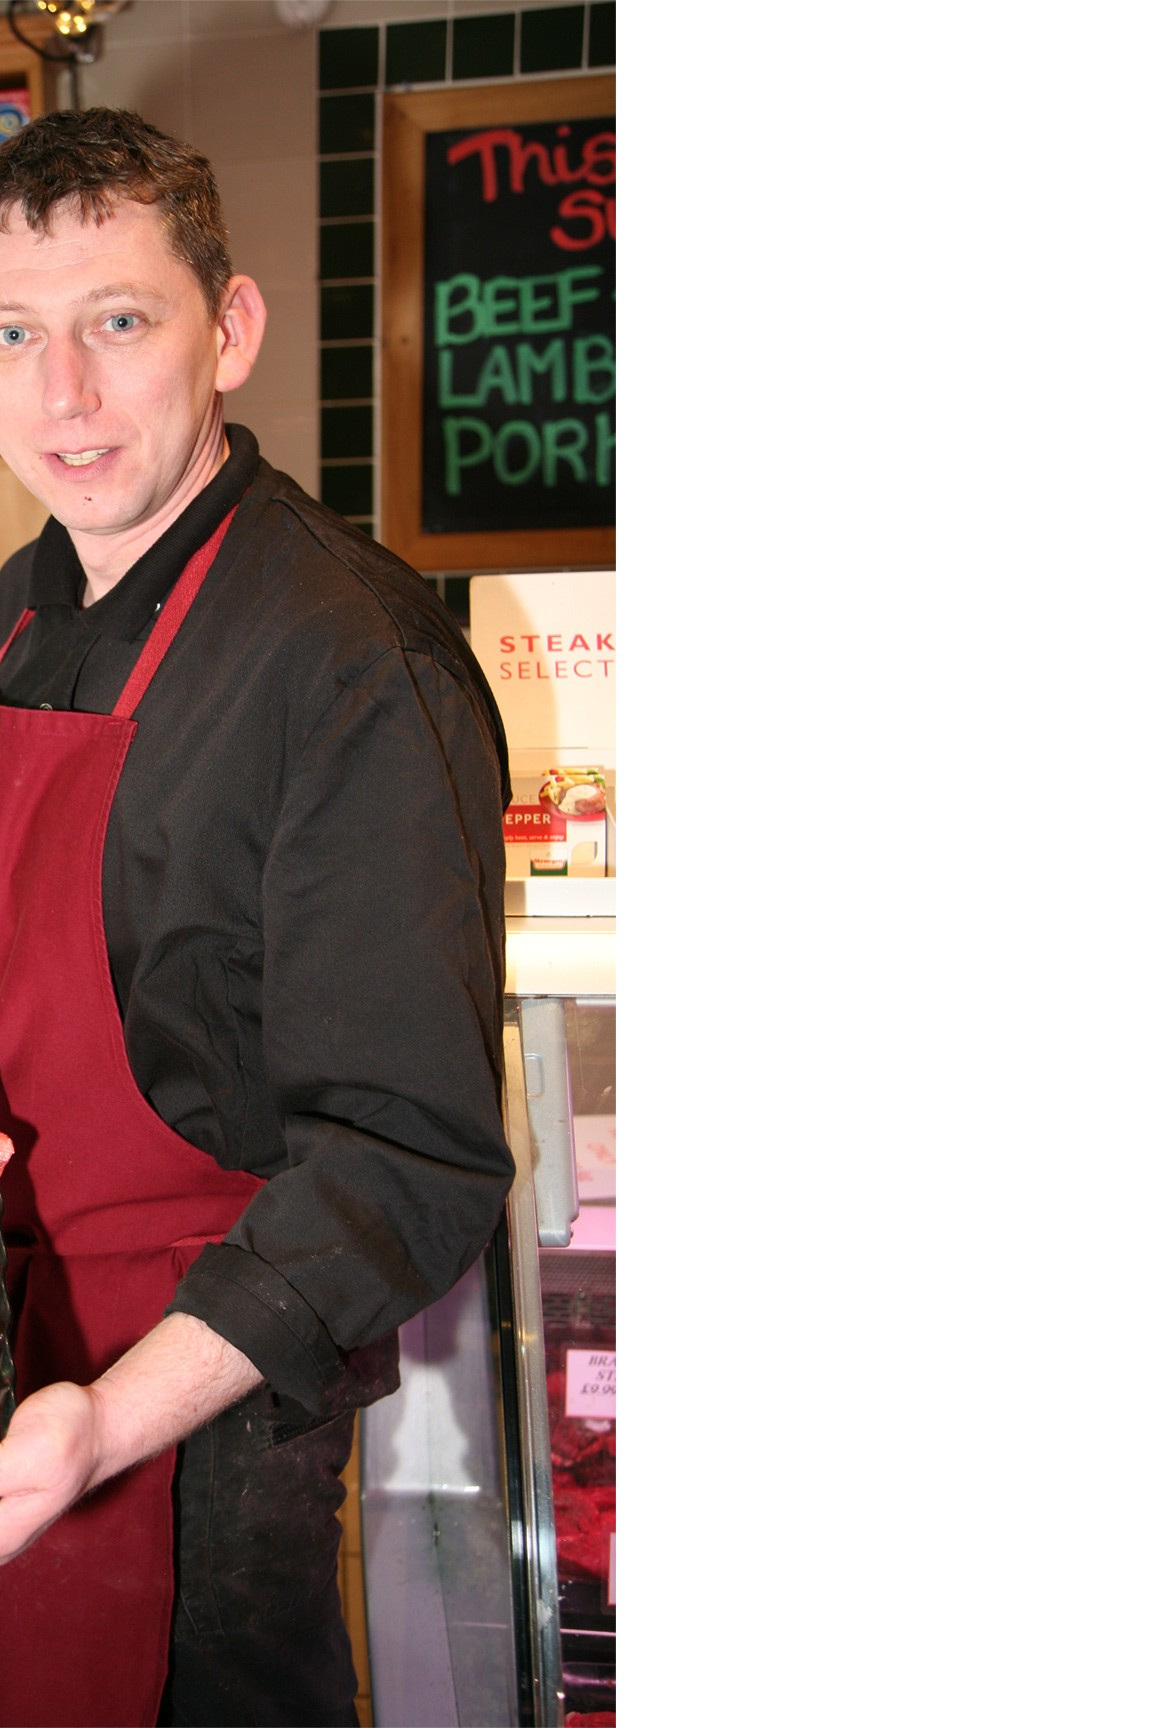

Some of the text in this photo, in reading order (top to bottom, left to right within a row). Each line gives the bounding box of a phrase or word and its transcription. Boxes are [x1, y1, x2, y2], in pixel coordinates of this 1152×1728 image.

[448, 125, 615, 203] This
[434, 265, 605, 348] BEEF
[437, 334, 615, 410] LAMB
[499, 633, 615, 653] STEAK
[499, 659, 615, 680] SELECT
[505, 813, 551, 825] EPPER
